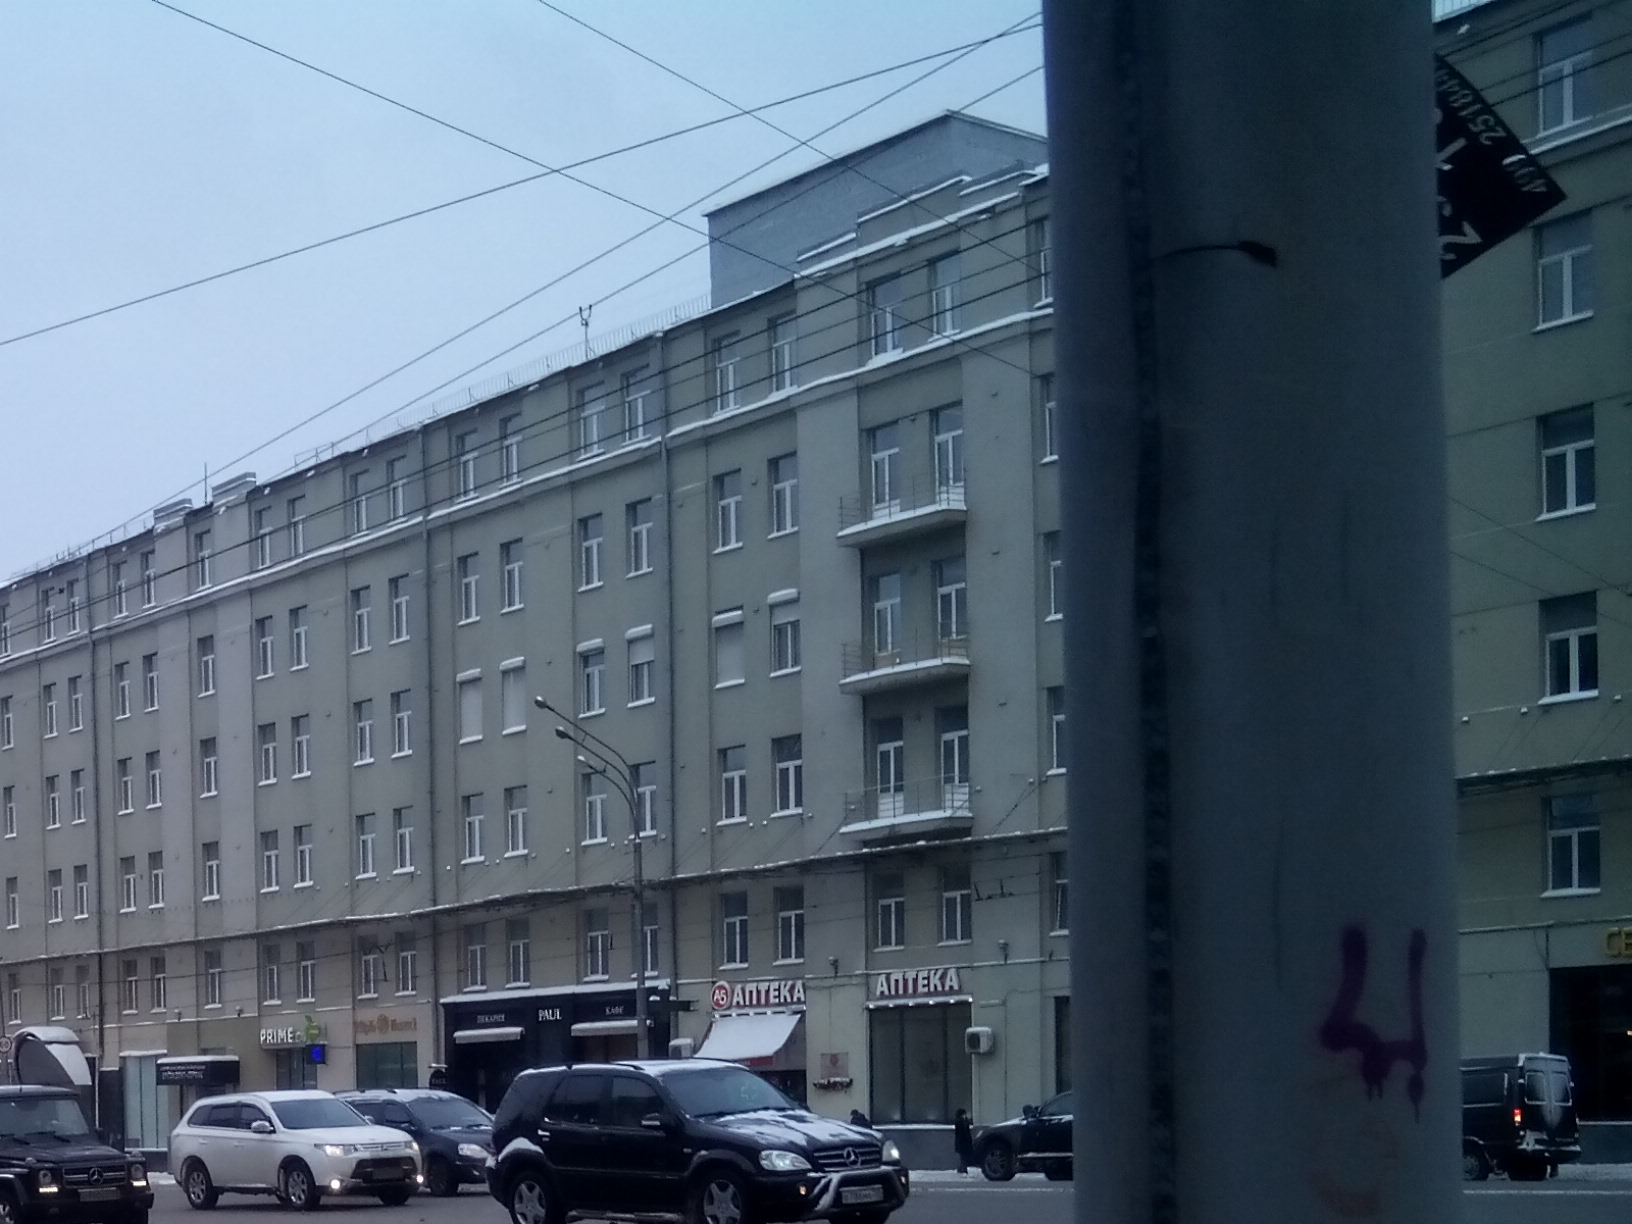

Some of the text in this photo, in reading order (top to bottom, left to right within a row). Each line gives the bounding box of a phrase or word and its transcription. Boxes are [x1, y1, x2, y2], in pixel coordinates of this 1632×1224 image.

[732, 980, 805, 1006] АПТЕКА
[876, 968, 960, 997] АПТЕКА
[538, 1008, 562, 1022] PAUL
[260, 1027, 294, 1044] PRIME
